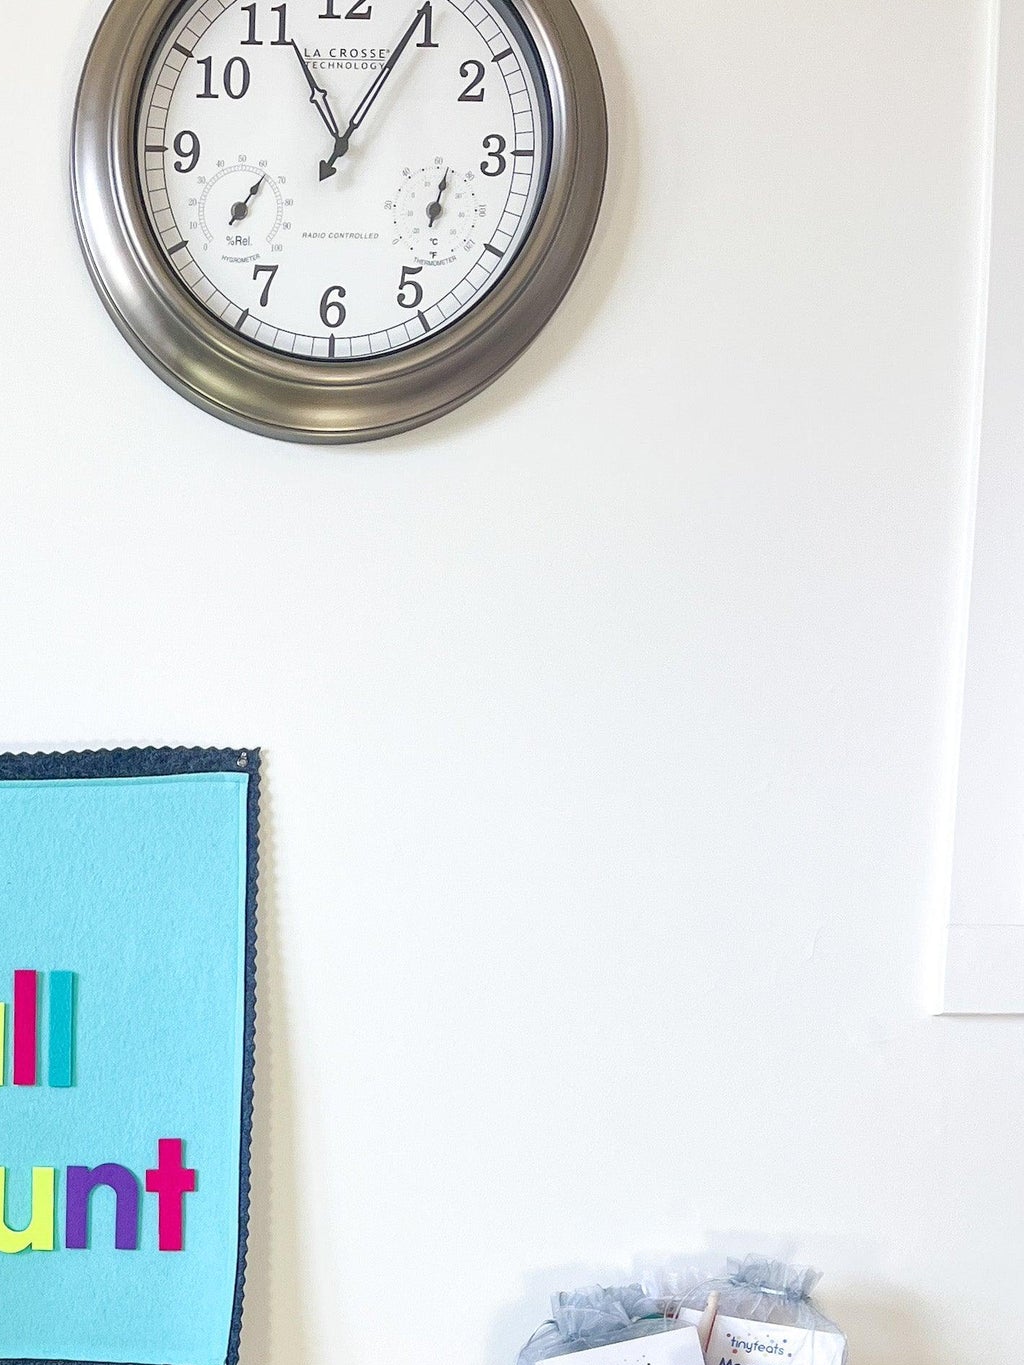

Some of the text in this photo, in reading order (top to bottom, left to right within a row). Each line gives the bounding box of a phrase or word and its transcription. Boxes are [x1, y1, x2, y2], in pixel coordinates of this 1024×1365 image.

[240, 3, 293, 45] 11
[416, 5, 439, 47] 1
[304, 48, 321, 58] LA
[305, 61, 386, 70] TECHNOLOGY
[195, 57, 250, 99] 10
[457, 60, 485, 102] 2
[173, 130, 201, 173] 9
[480, 134, 507, 177] 3
[278, 176, 286, 184] 70
[189, 222, 197, 230] 10
[226, 235, 253, 246] %Rel.
[271, 243, 283, 252] 100
[253, 265, 279, 307] 7
[320, 285, 347, 328] 6
[397, 266, 424, 309] 5
[731, 1337, 784, 1356] tinyfeats
